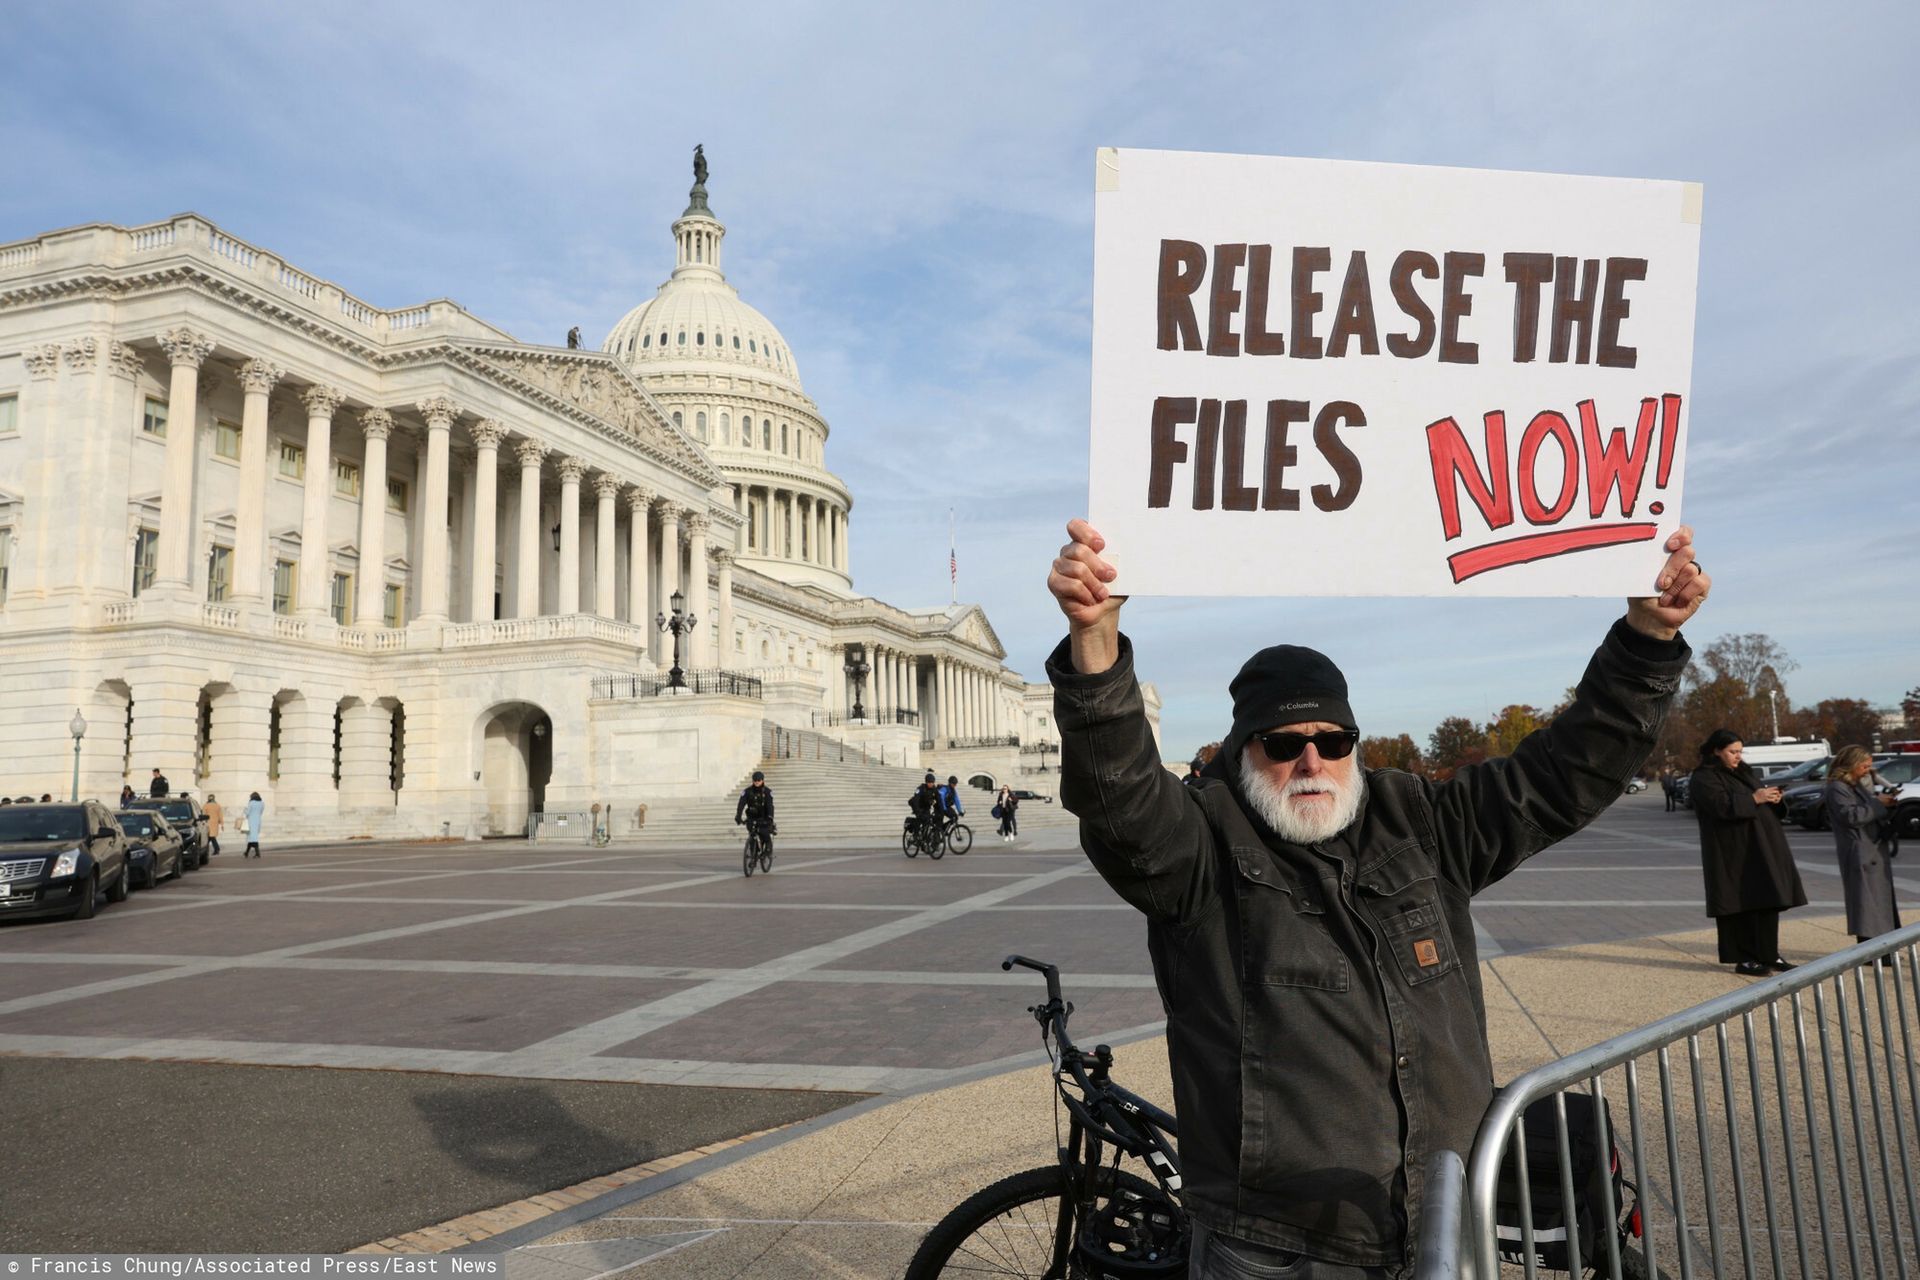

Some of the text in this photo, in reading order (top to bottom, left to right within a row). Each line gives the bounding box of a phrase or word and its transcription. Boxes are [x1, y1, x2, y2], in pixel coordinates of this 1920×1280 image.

[1156, 239, 1648, 368] RELEASE THE
[1147, 393, 1682, 541] FILES NOW!
[1286, 701, 1319, 710] Columbia
